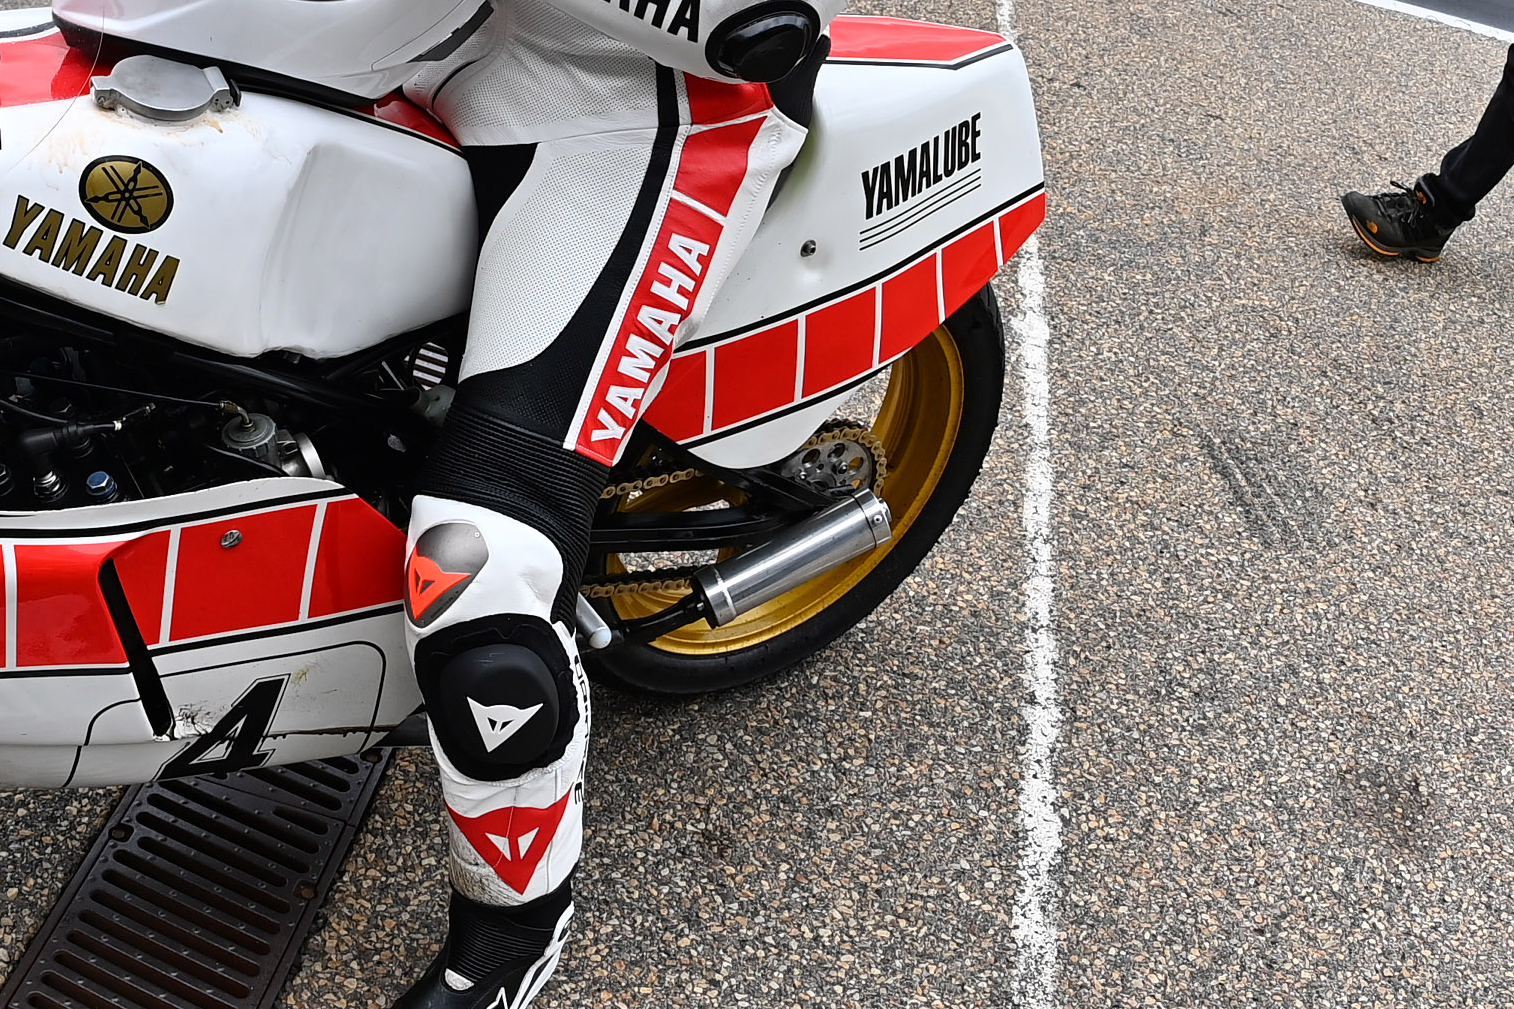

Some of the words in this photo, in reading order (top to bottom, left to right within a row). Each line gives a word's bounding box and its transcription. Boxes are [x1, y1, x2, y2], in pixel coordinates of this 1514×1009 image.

[860, 112, 982, 220] YAMALUBE
[3, 194, 181, 305] YAMAHA
[590, 230, 711, 444] YAMAHA
[151, 673, 292, 782] 4
